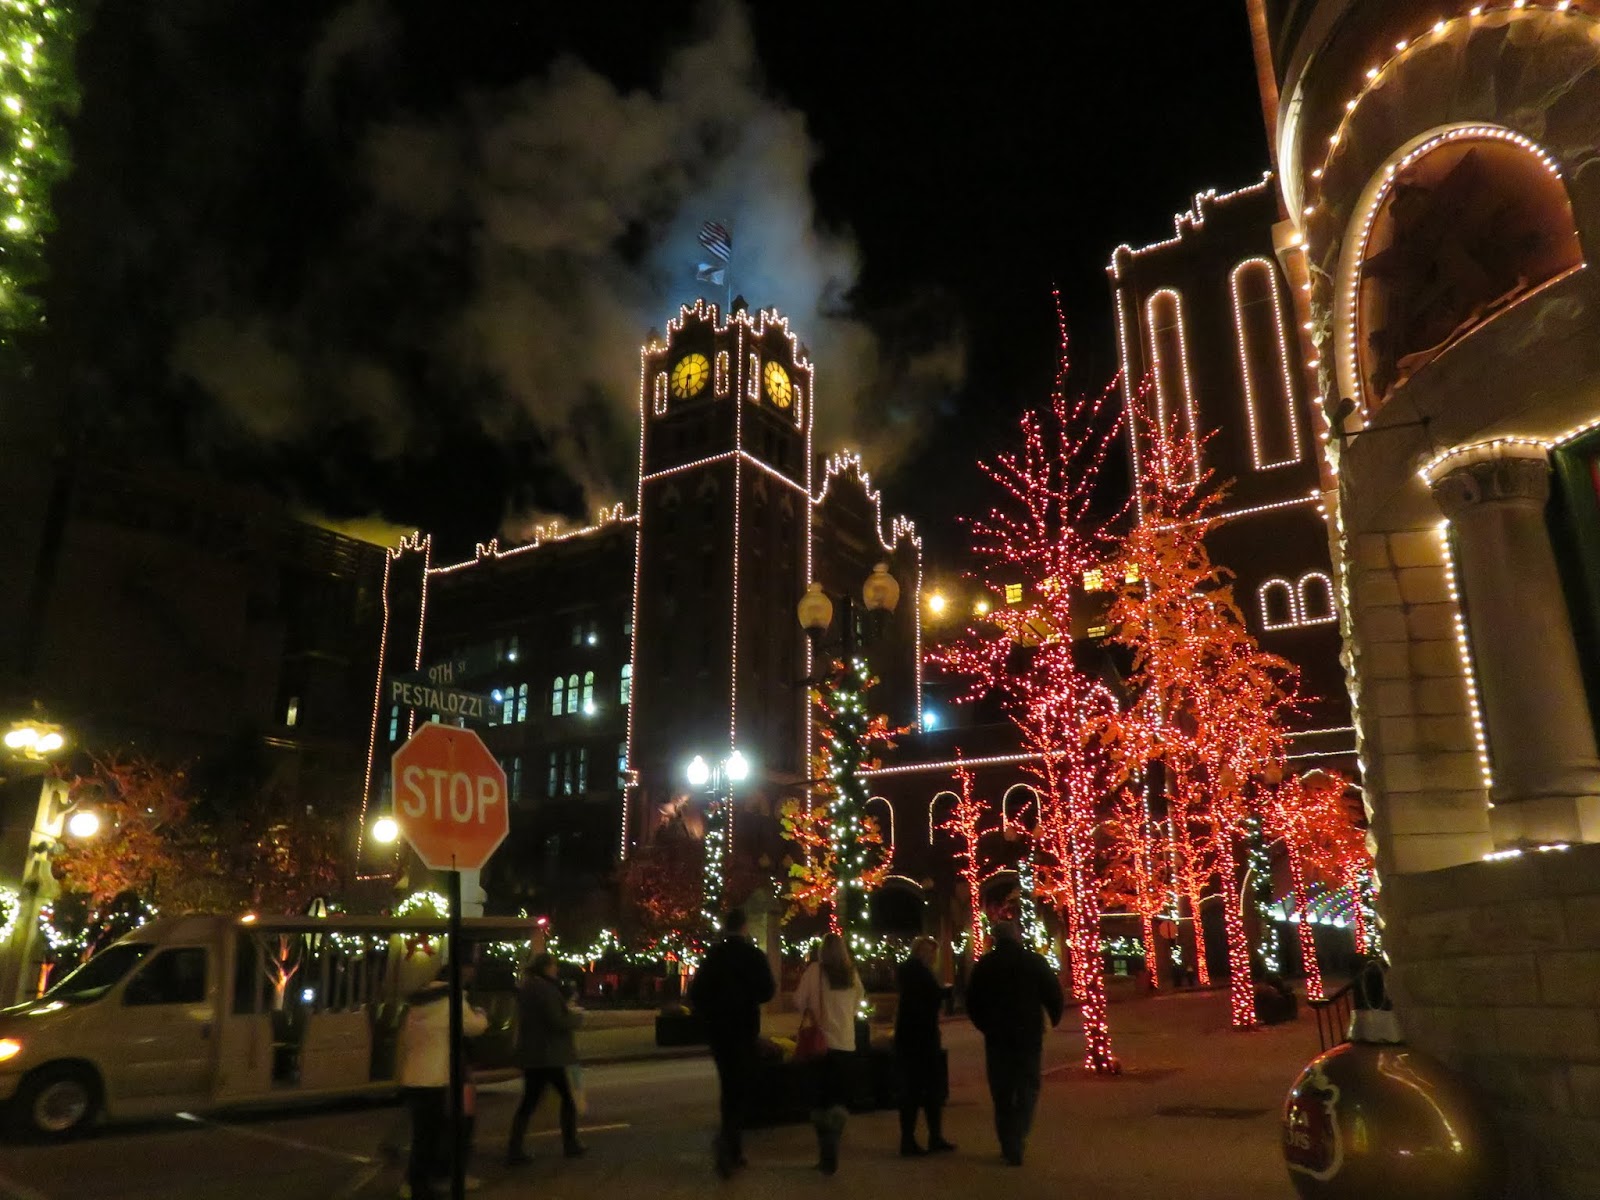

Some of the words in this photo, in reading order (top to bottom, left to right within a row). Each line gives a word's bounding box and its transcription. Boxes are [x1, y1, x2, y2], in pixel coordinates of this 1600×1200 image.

[428, 661, 453, 684] 9TH
[458, 661, 467, 673] ST
[392, 681, 483, 718] PESTALOZZI
[488, 705, 496, 716] ST
[402, 765, 500, 824] STOP
